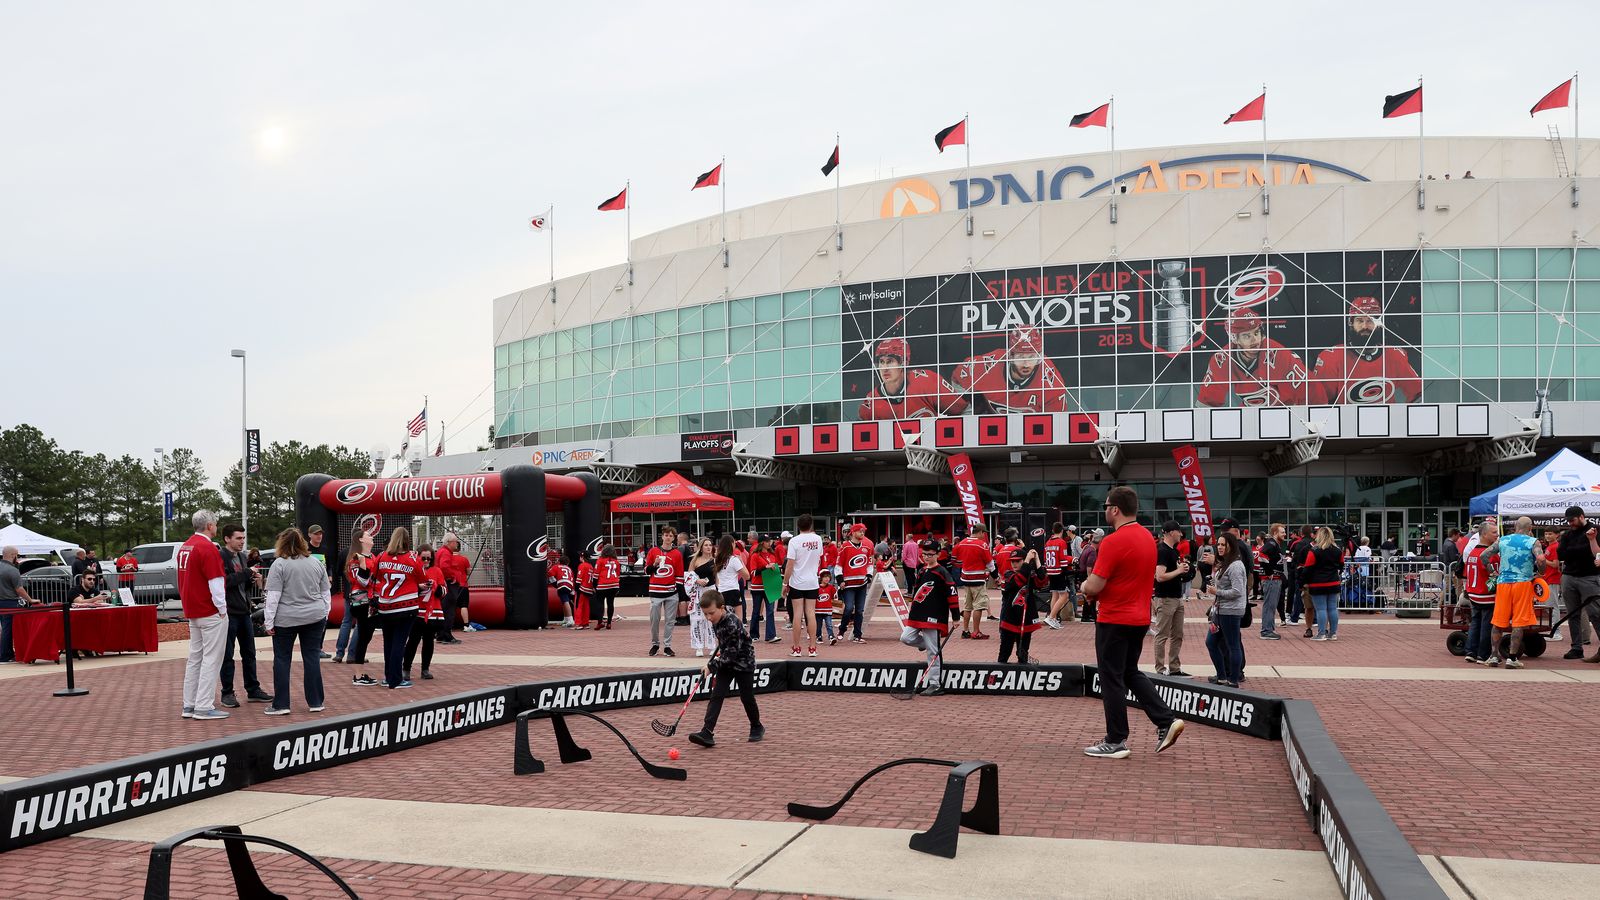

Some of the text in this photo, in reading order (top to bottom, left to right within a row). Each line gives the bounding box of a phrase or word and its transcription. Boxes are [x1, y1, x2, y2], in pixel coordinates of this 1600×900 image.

[950, 166, 1094, 210] PNC
[859, 289, 902, 301] invisalign
[986, 271, 1131, 299] STANLEY CUP
[961, 294, 1132, 332] PLAYOFFS
[1098, 334, 1133, 347] 2023
[249, 431, 258, 464] CANES
[543, 449, 593, 463] PNC AREN
[683, 440, 719, 449] PLAYOFFS
[383, 477, 485, 502] MOBILE TOUR
[1181, 474, 1212, 537] CANES
[179, 550, 190, 569] 17
[604, 563, 617, 579] 74
[1045, 551, 1056, 567] 86
[380, 572, 406, 597] 17
[1466, 563, 1478, 588] 17
[801, 666, 908, 688] CAROLINA
[537, 679, 643, 711] CAROLINA
[273, 695, 505, 771] CAROLINA HURRICANES
[10, 754, 228, 839] HURRICANES
